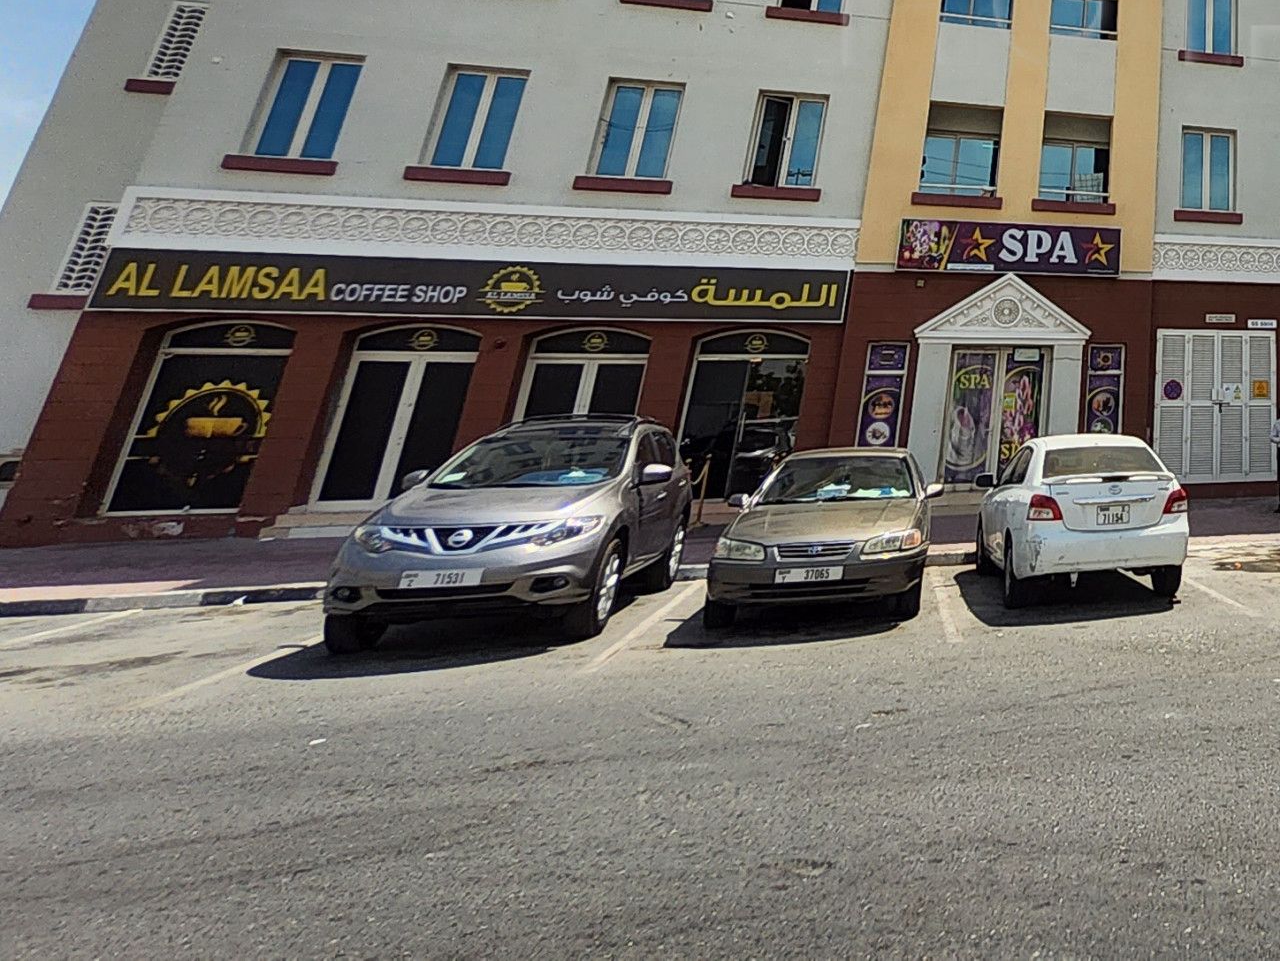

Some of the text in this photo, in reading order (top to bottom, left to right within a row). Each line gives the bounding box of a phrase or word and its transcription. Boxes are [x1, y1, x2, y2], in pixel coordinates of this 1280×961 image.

[998, 228, 1078, 264] SPA
[106, 261, 468, 305] AL LAMSAA COFFEE SHOP
[556, 277, 838, 310] اللمسة كوفي شوب
[959, 373, 992, 390] SPA
[433, 572, 466, 586] 71531
[803, 569, 831, 582] 37065
